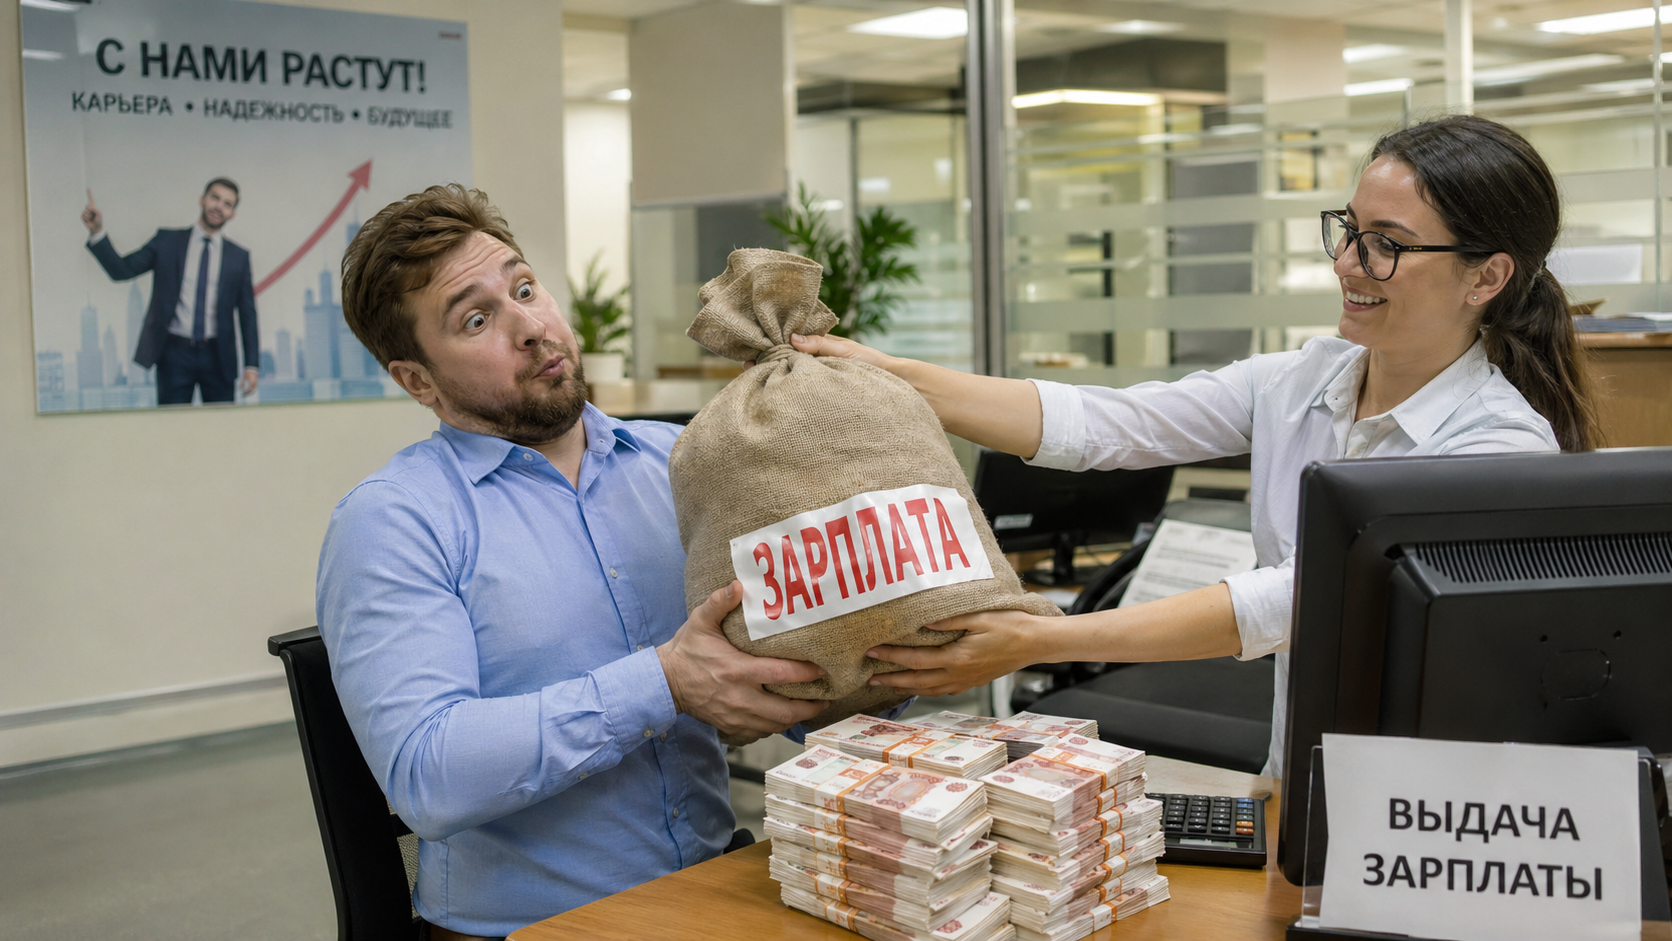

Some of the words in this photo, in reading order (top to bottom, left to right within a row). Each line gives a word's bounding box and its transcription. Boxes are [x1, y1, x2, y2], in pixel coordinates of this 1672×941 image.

[96, 37, 126, 76] С
[140, 40, 267, 84] НАМИ
[282, 51, 427, 94] РАСТУТ!
[72, 91, 173, 116] КАРЬЕРА
[204, 97, 345, 124] НАДЕЖНОСТЬ
[367, 104, 454, 130] БУДУЩЕЕ
[753, 497, 972, 621] ЗАРПЛАТА
[1388, 797, 1581, 844] ВЫДАЧА
[1362, 852, 1603, 901] ЗАРПЛАТЫ
